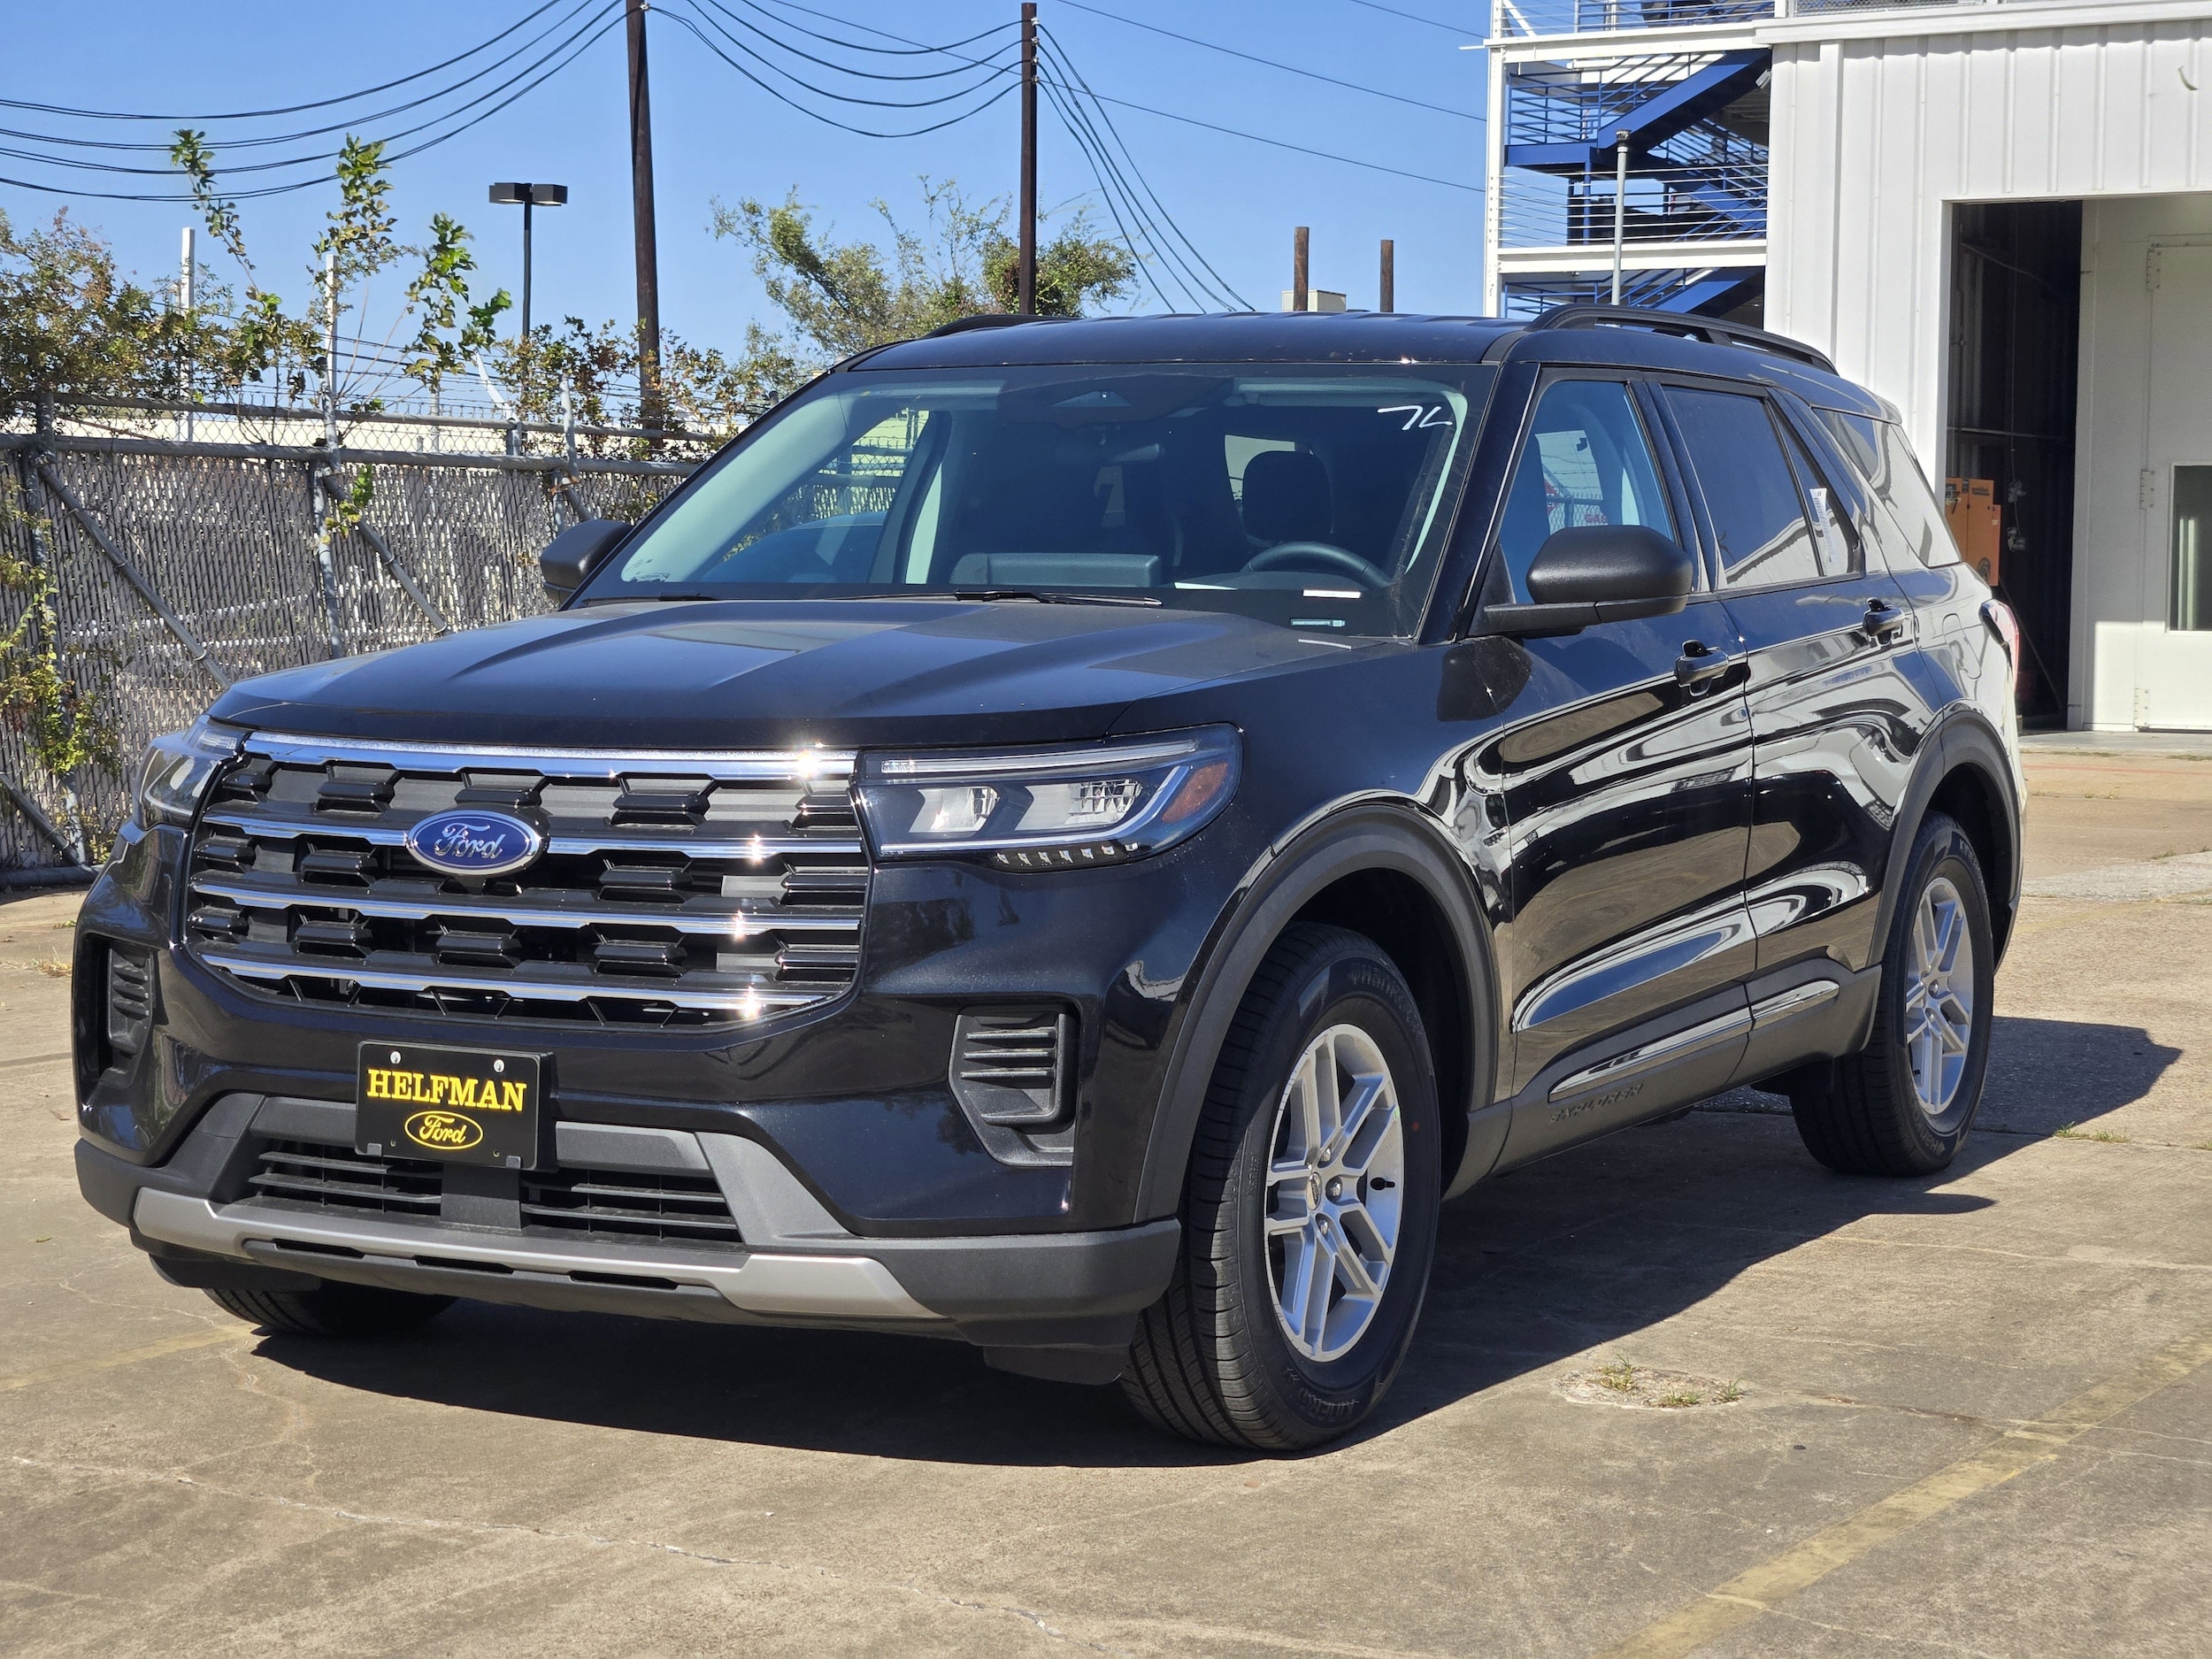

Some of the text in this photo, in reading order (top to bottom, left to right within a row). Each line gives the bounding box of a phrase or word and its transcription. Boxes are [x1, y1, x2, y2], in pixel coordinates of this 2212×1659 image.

[434, 822, 504, 860] Ford
[367, 1069, 527, 1112] HELFMAN
[419, 1115, 468, 1144] Ford
